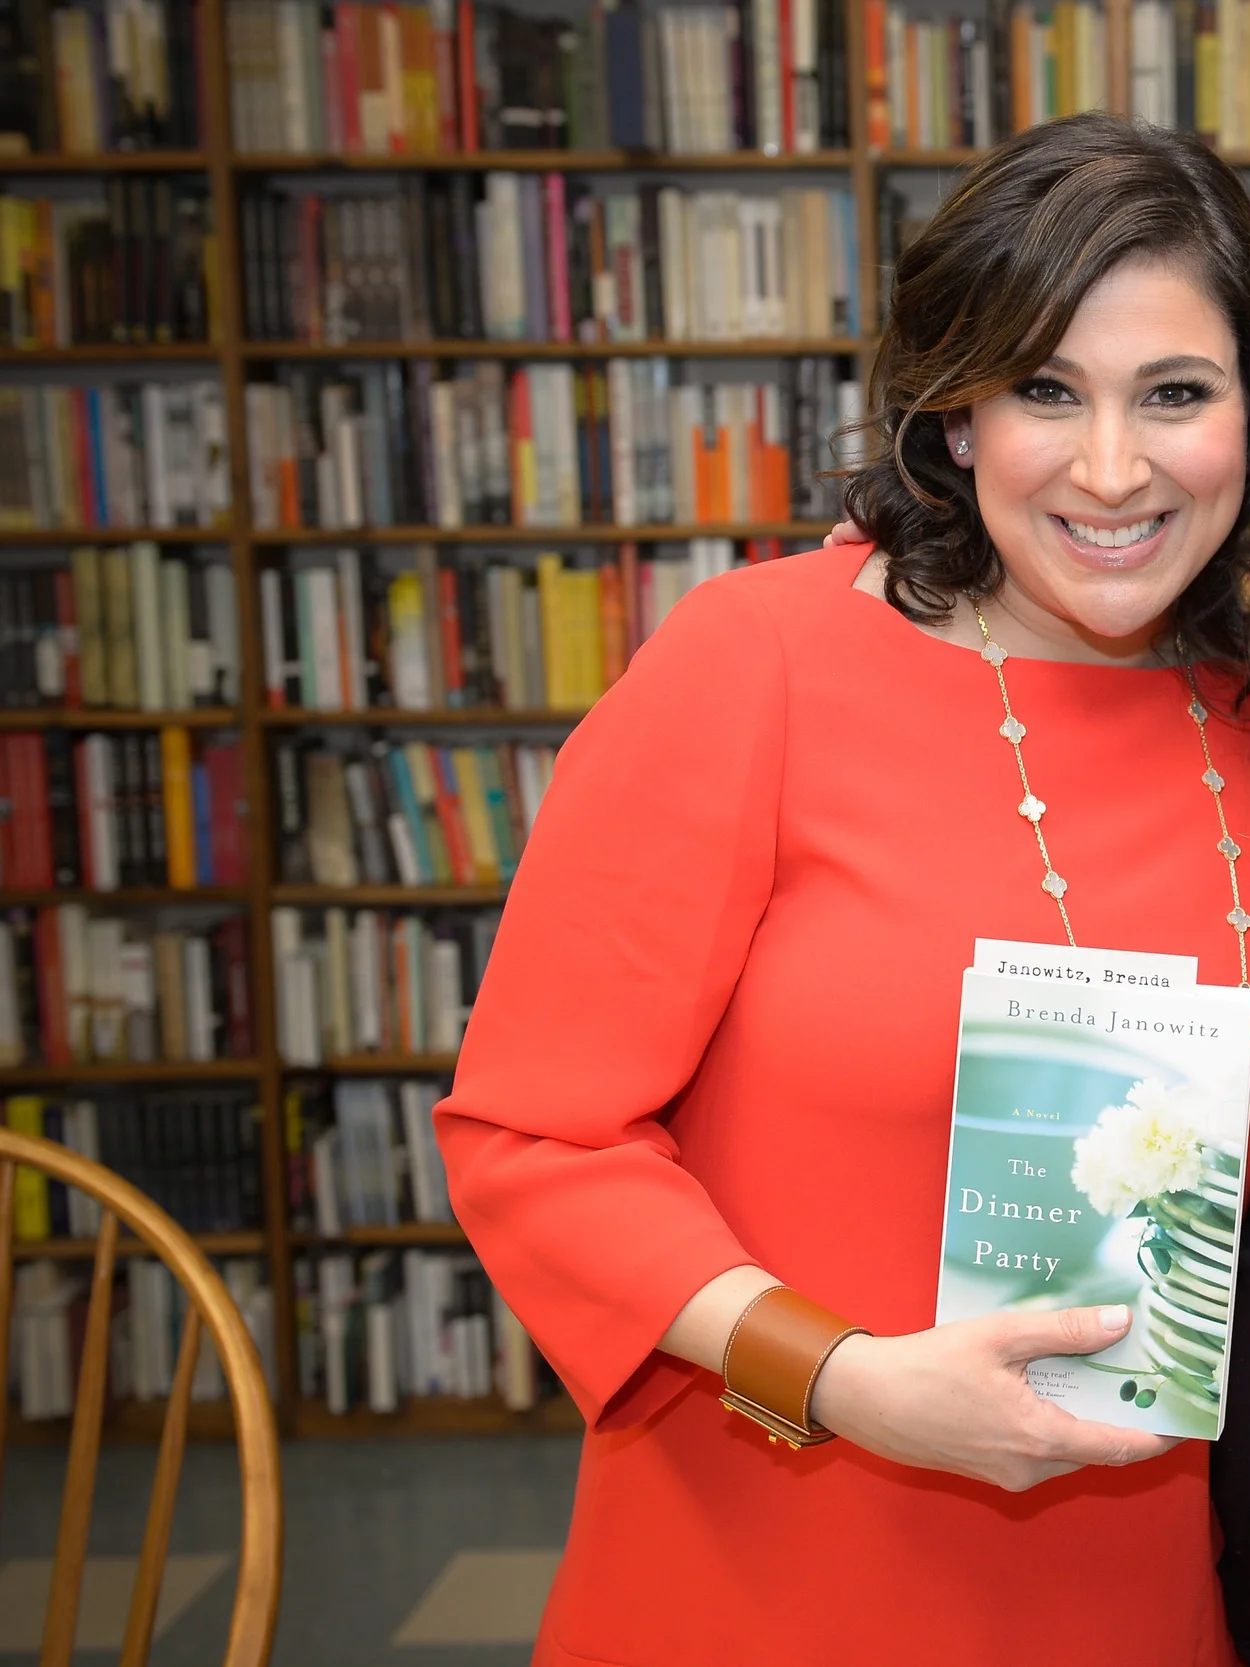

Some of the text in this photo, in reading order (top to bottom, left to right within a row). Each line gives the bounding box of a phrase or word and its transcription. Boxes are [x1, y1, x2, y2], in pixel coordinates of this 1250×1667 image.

[998, 961, 1171, 988] Janowitz, Brenda
[1007, 1000, 1220, 1039] Brenda Janowitz
[1012, 1108, 1061, 1120] A Novel
[1007, 1159, 1047, 1178] The
[959, 1188, 1082, 1224] Dinner
[972, 1240, 1061, 1281] Party
[1026, 1368, 1049, 1379] ining
